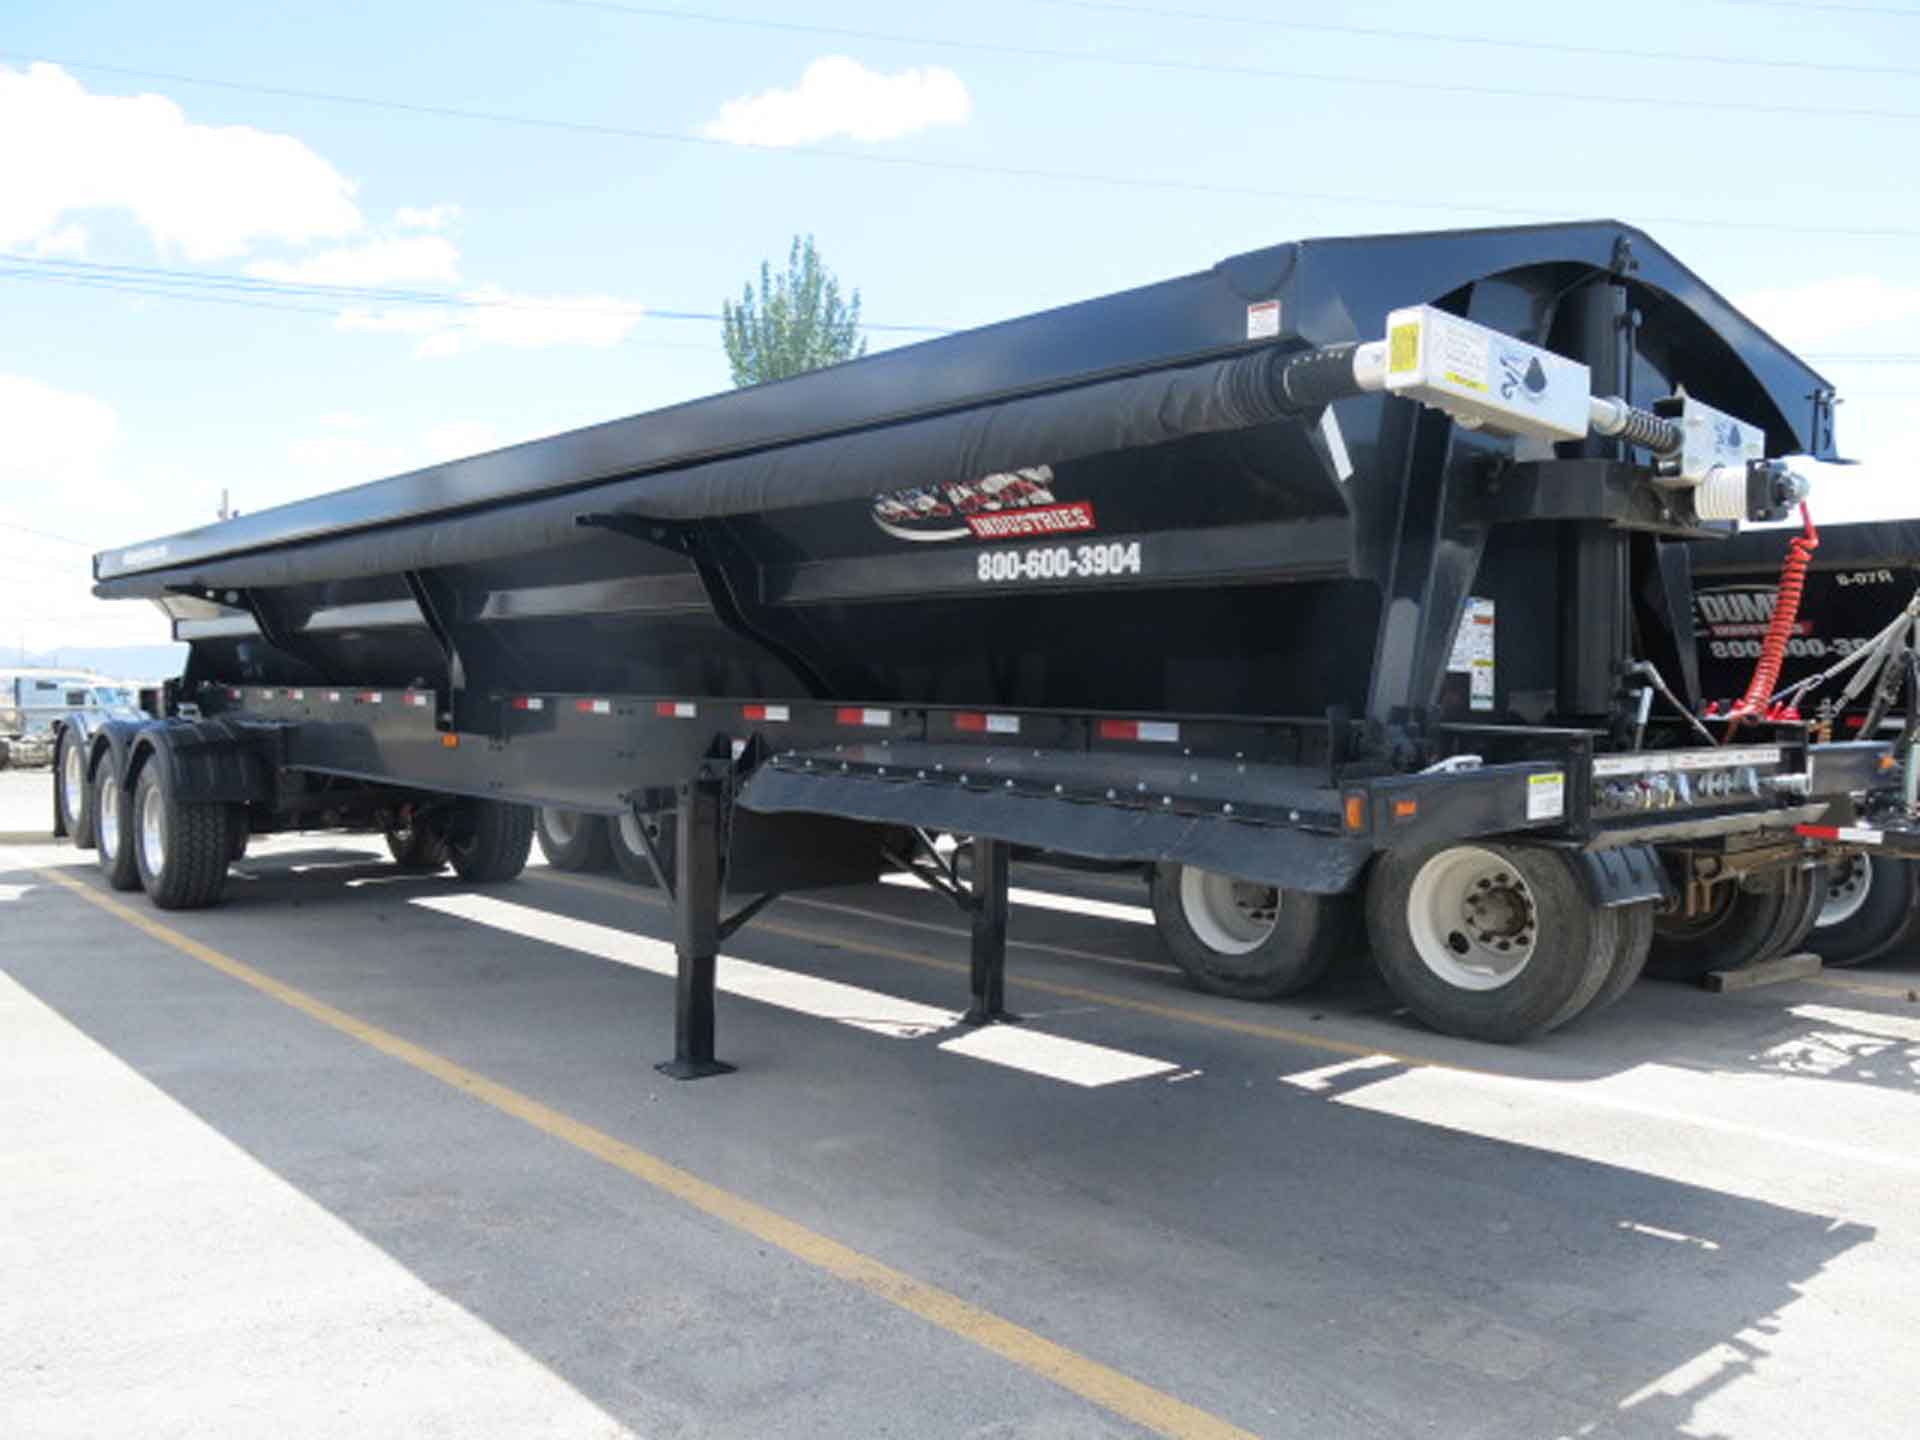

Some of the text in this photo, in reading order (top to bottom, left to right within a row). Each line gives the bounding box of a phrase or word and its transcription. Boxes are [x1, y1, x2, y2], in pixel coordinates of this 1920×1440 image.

[970, 508, 1091, 537] INDUSTRIES
[977, 542, 1142, 581] 800-600-3904
[1698, 592, 1781, 623] DUM
